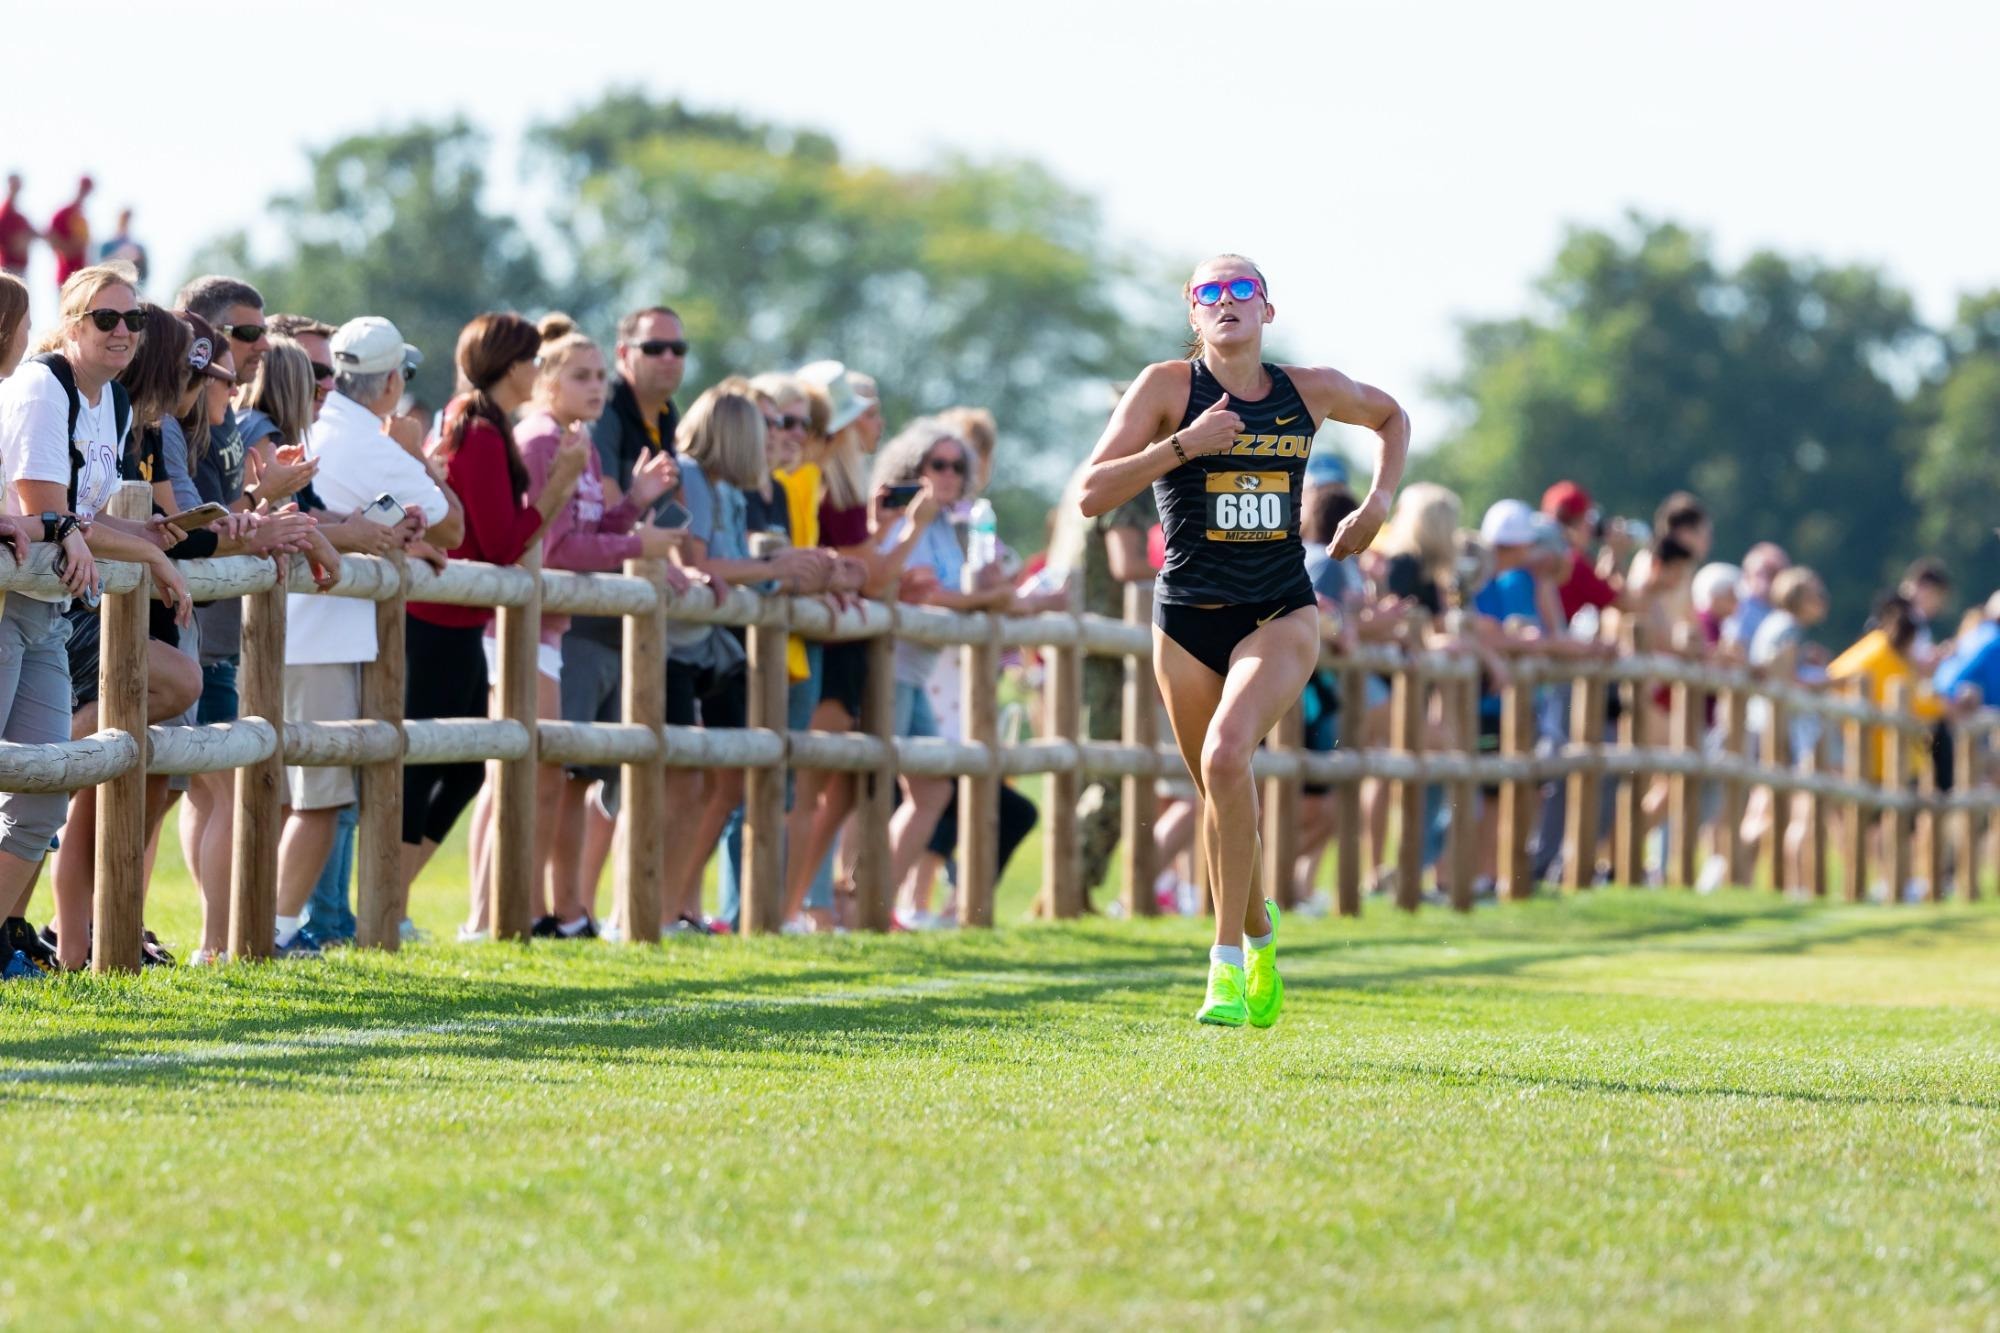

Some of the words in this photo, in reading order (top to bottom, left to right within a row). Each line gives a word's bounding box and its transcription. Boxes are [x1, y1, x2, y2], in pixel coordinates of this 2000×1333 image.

[1198, 434, 1312, 459] ZZOU
[1216, 493, 1281, 530] 680
[1225, 531, 1272, 540] MIZZOU
